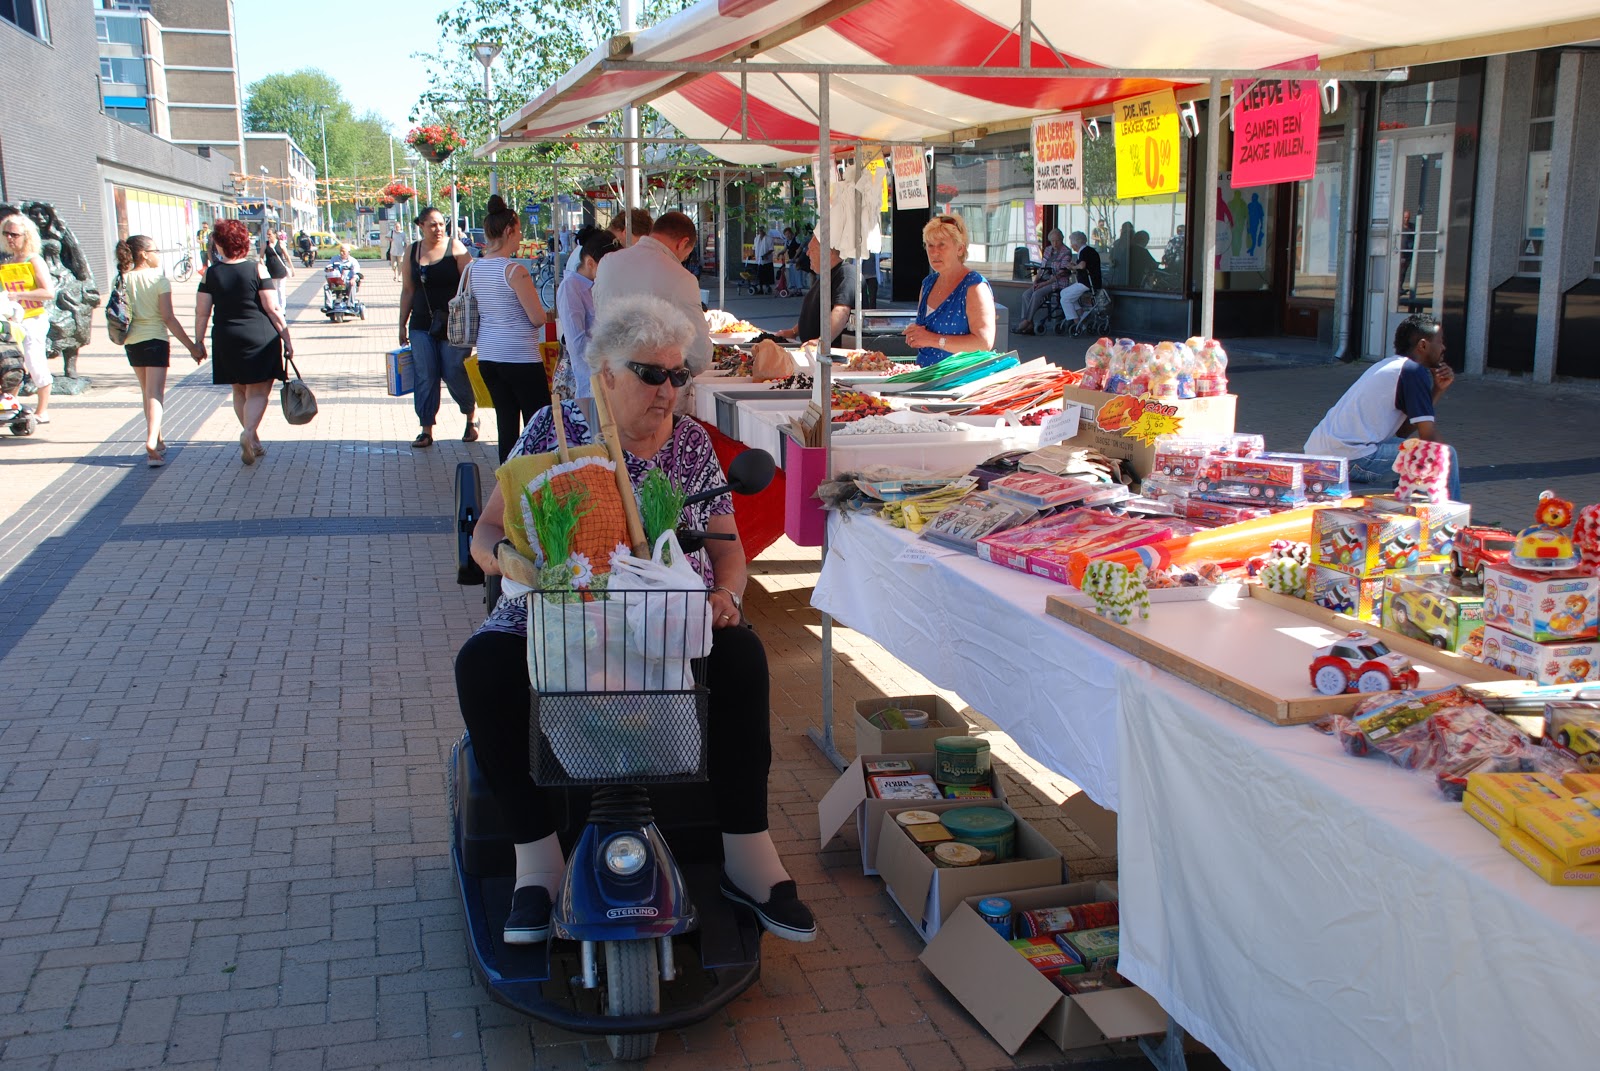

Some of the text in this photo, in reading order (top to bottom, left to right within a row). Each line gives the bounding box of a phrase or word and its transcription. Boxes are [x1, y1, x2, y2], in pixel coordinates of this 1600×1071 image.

[1241, 79, 1302, 112] LIEFDE IS
[1244, 111, 1303, 143] SAMEN EEN
[1240, 142, 1271, 165] ZAKJE
[1145, 403, 1177, 416] SALE
[942, 760, 985, 777] Biscuits
[1563, 870, 1595, 880] Colour
[610, 909, 655, 917] STERLING
